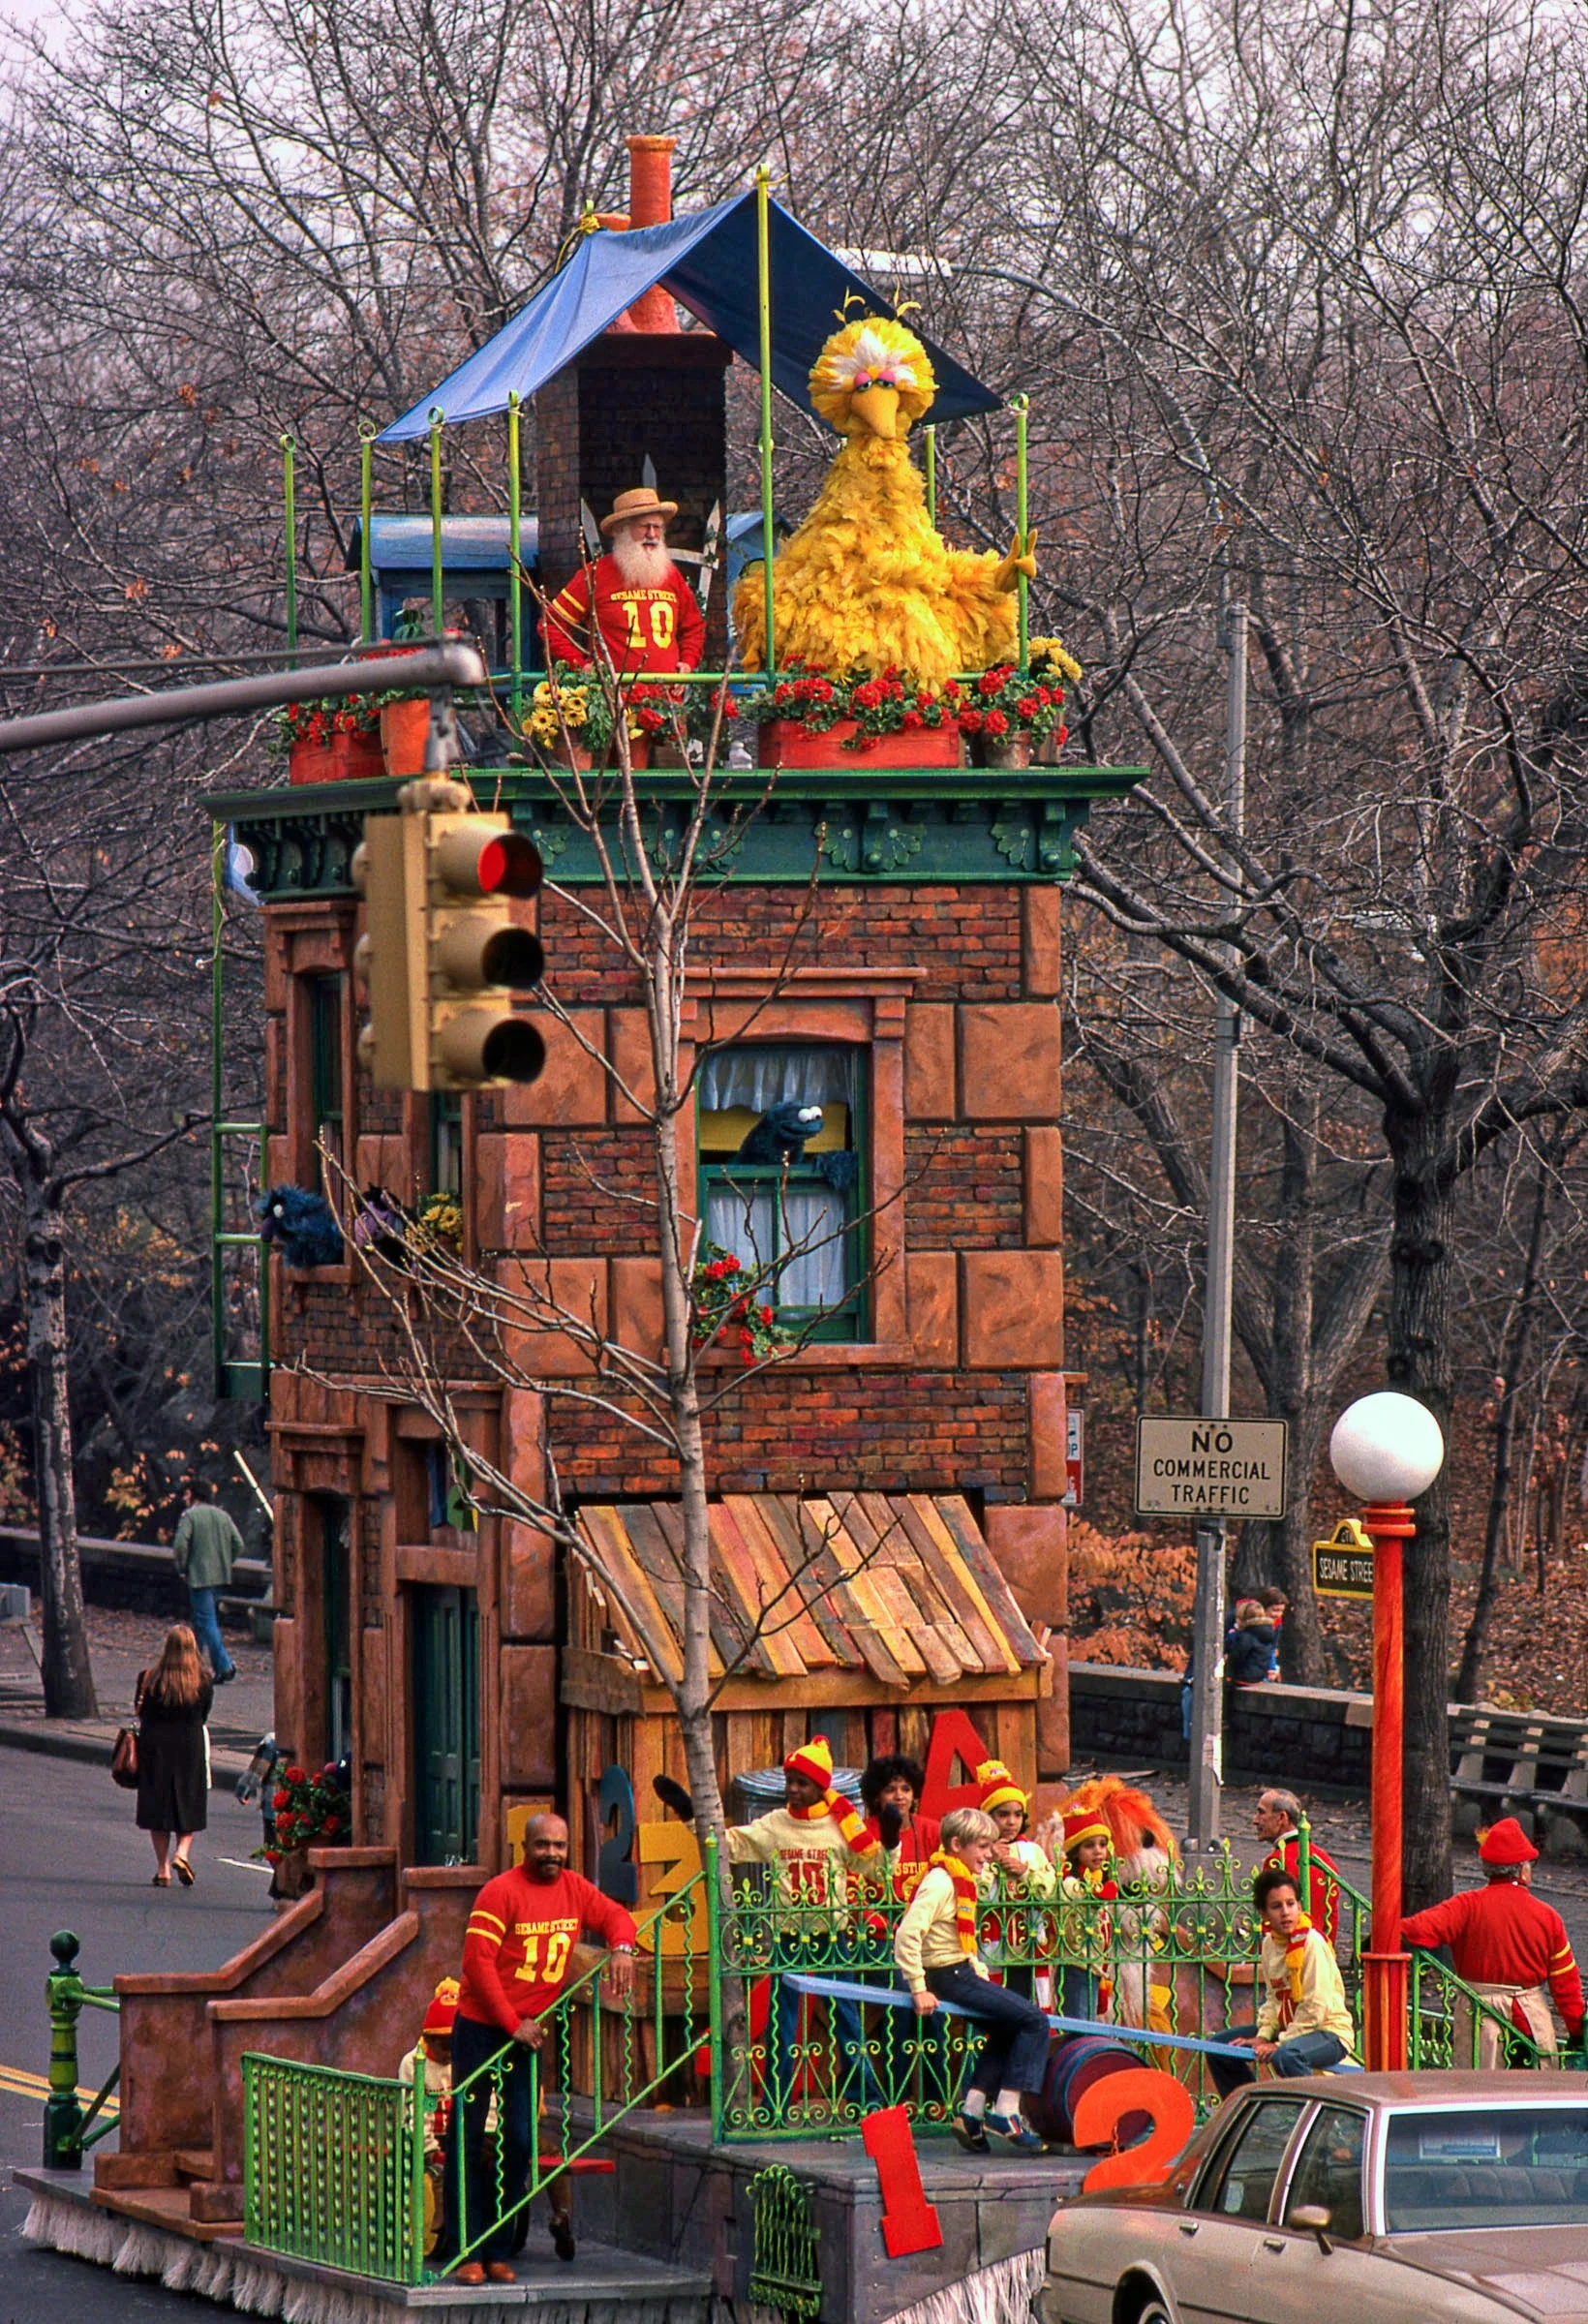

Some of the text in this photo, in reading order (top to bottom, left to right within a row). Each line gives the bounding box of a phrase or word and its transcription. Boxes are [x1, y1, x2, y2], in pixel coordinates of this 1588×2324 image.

[610, 589, 647, 601] SESAME
[623, 601, 674, 649] 10
[1191, 1430, 1234, 1453] NO
[1153, 1458, 1271, 1481] COMMERCIAL
[1172, 1483, 1250, 1505] TRAFFIC
[1319, 1557, 1373, 1583] SESAME STREE
[515, 1918, 579, 1935] SESAME STREET
[514, 1932, 571, 1984] 10
[1074, 2067, 1195, 2193] 2
